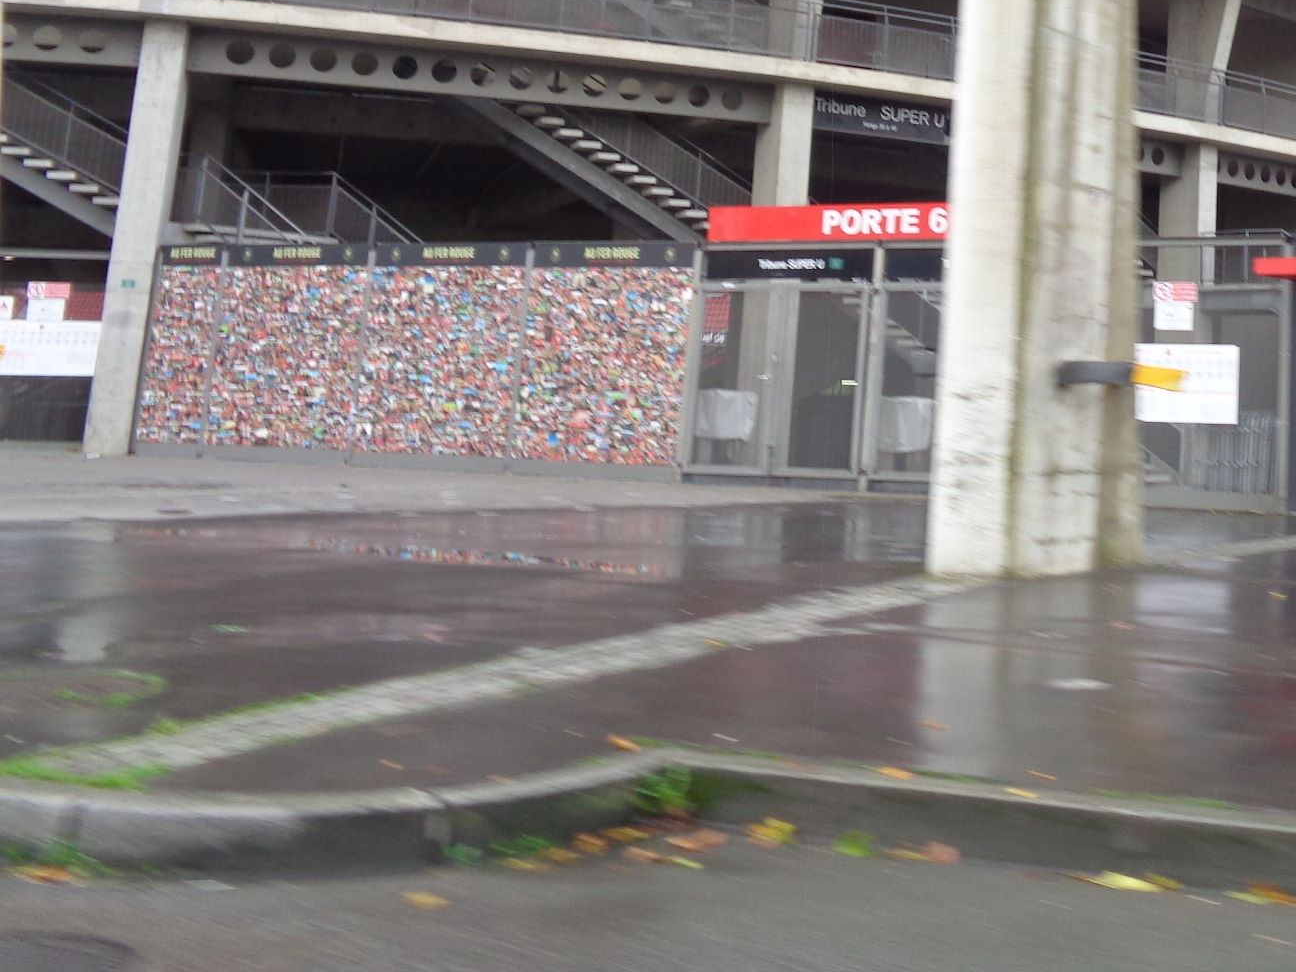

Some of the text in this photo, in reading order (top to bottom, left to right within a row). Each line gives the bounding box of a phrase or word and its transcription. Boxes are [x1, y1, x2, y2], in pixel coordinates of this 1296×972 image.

[815, 96, 867, 118] Tribune
[880, 105, 930, 127] SUPER
[934, 113, 945, 128] U
[821, 207, 948, 236] PORTE 6
